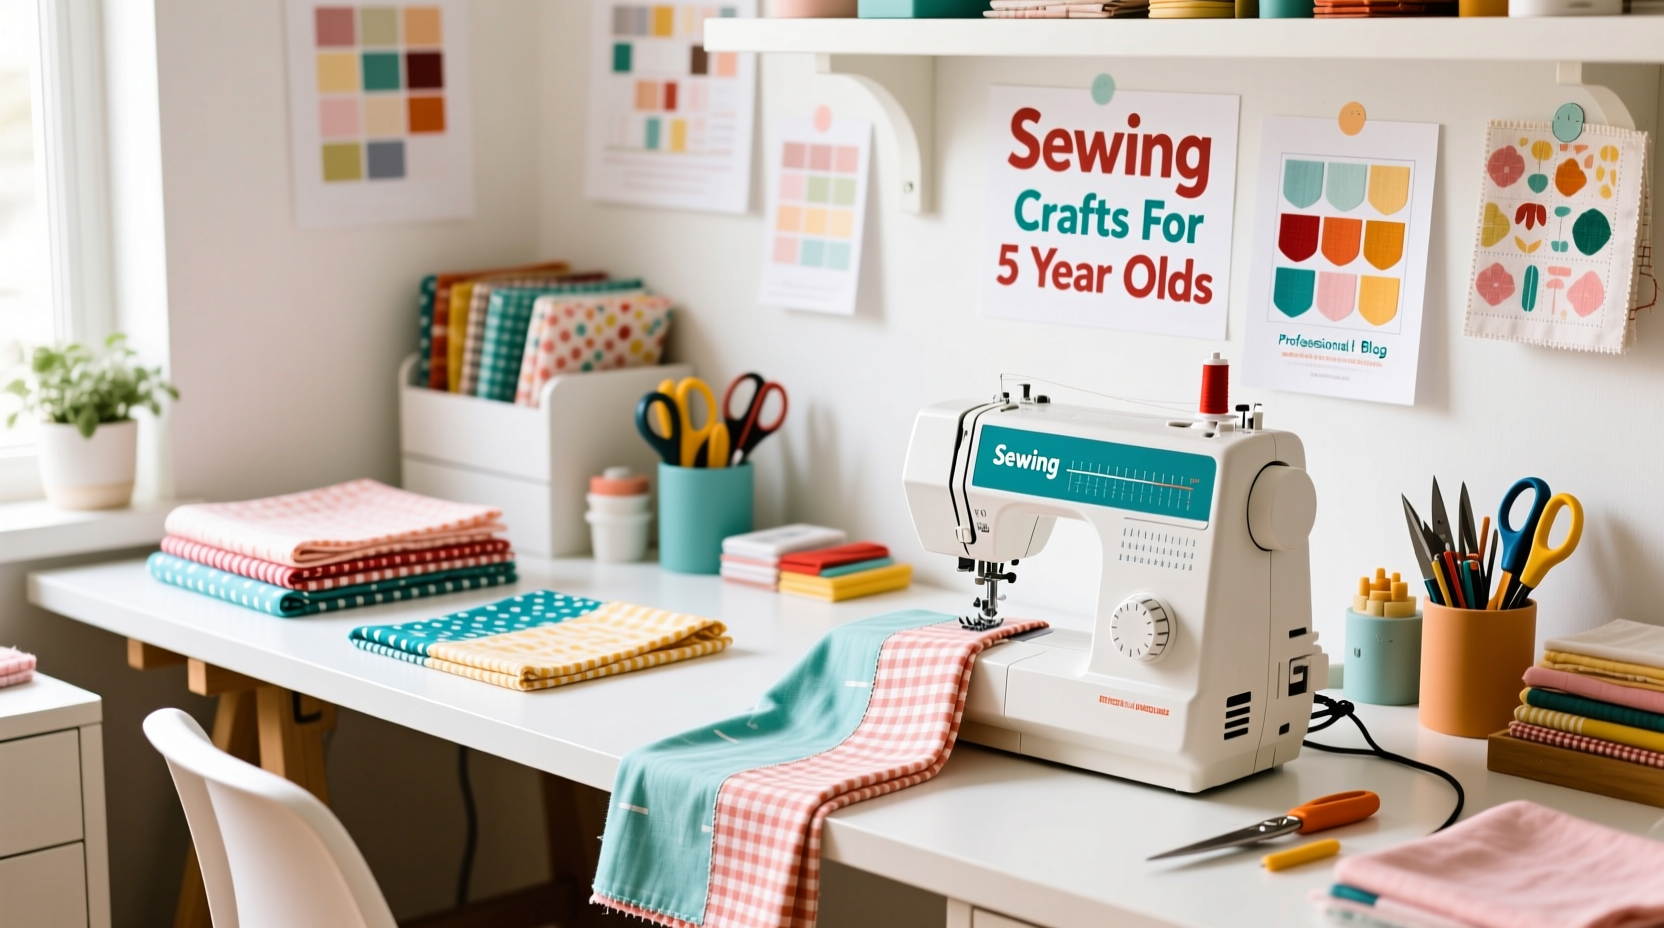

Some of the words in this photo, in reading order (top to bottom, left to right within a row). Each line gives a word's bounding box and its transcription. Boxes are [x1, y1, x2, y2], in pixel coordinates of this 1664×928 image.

[1008, 107, 1212, 199] Sewing
[1013, 188, 1130, 240] Crafts
[1141, 198, 1205, 244] For
[996, 243, 1019, 286] 5
[1030, 245, 1113, 294] Year
[1122, 253, 1213, 305] Olds
[1361, 340, 1388, 359] Blog
[992, 443, 1060, 480] Sewing
